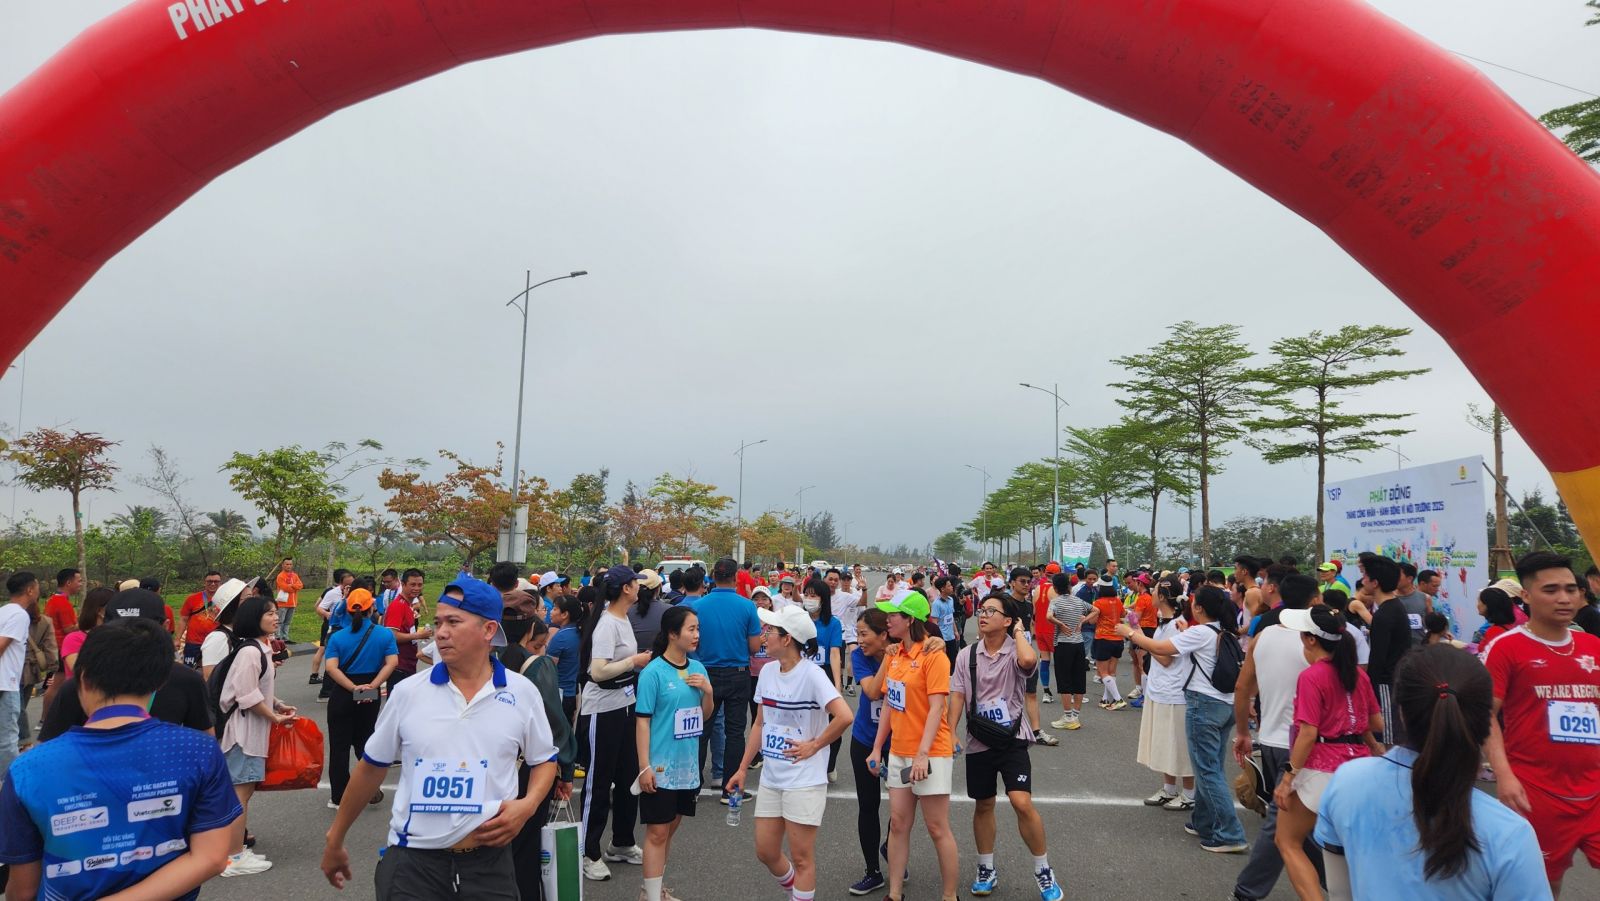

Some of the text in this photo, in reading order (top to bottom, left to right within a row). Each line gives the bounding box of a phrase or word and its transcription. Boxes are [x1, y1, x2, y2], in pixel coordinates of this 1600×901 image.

[1369, 483, 1411, 504] PHÁT ĐỘNG
[1535, 685, 1551, 698] WE
[1552, 685, 1571, 698] ARE
[683, 716, 699, 730] 1171
[1560, 715, 1597, 734] 0291
[423, 776, 473, 798] 0951
[133, 806, 175, 816] Vietcombank
[54, 816, 77, 826] DEEP
